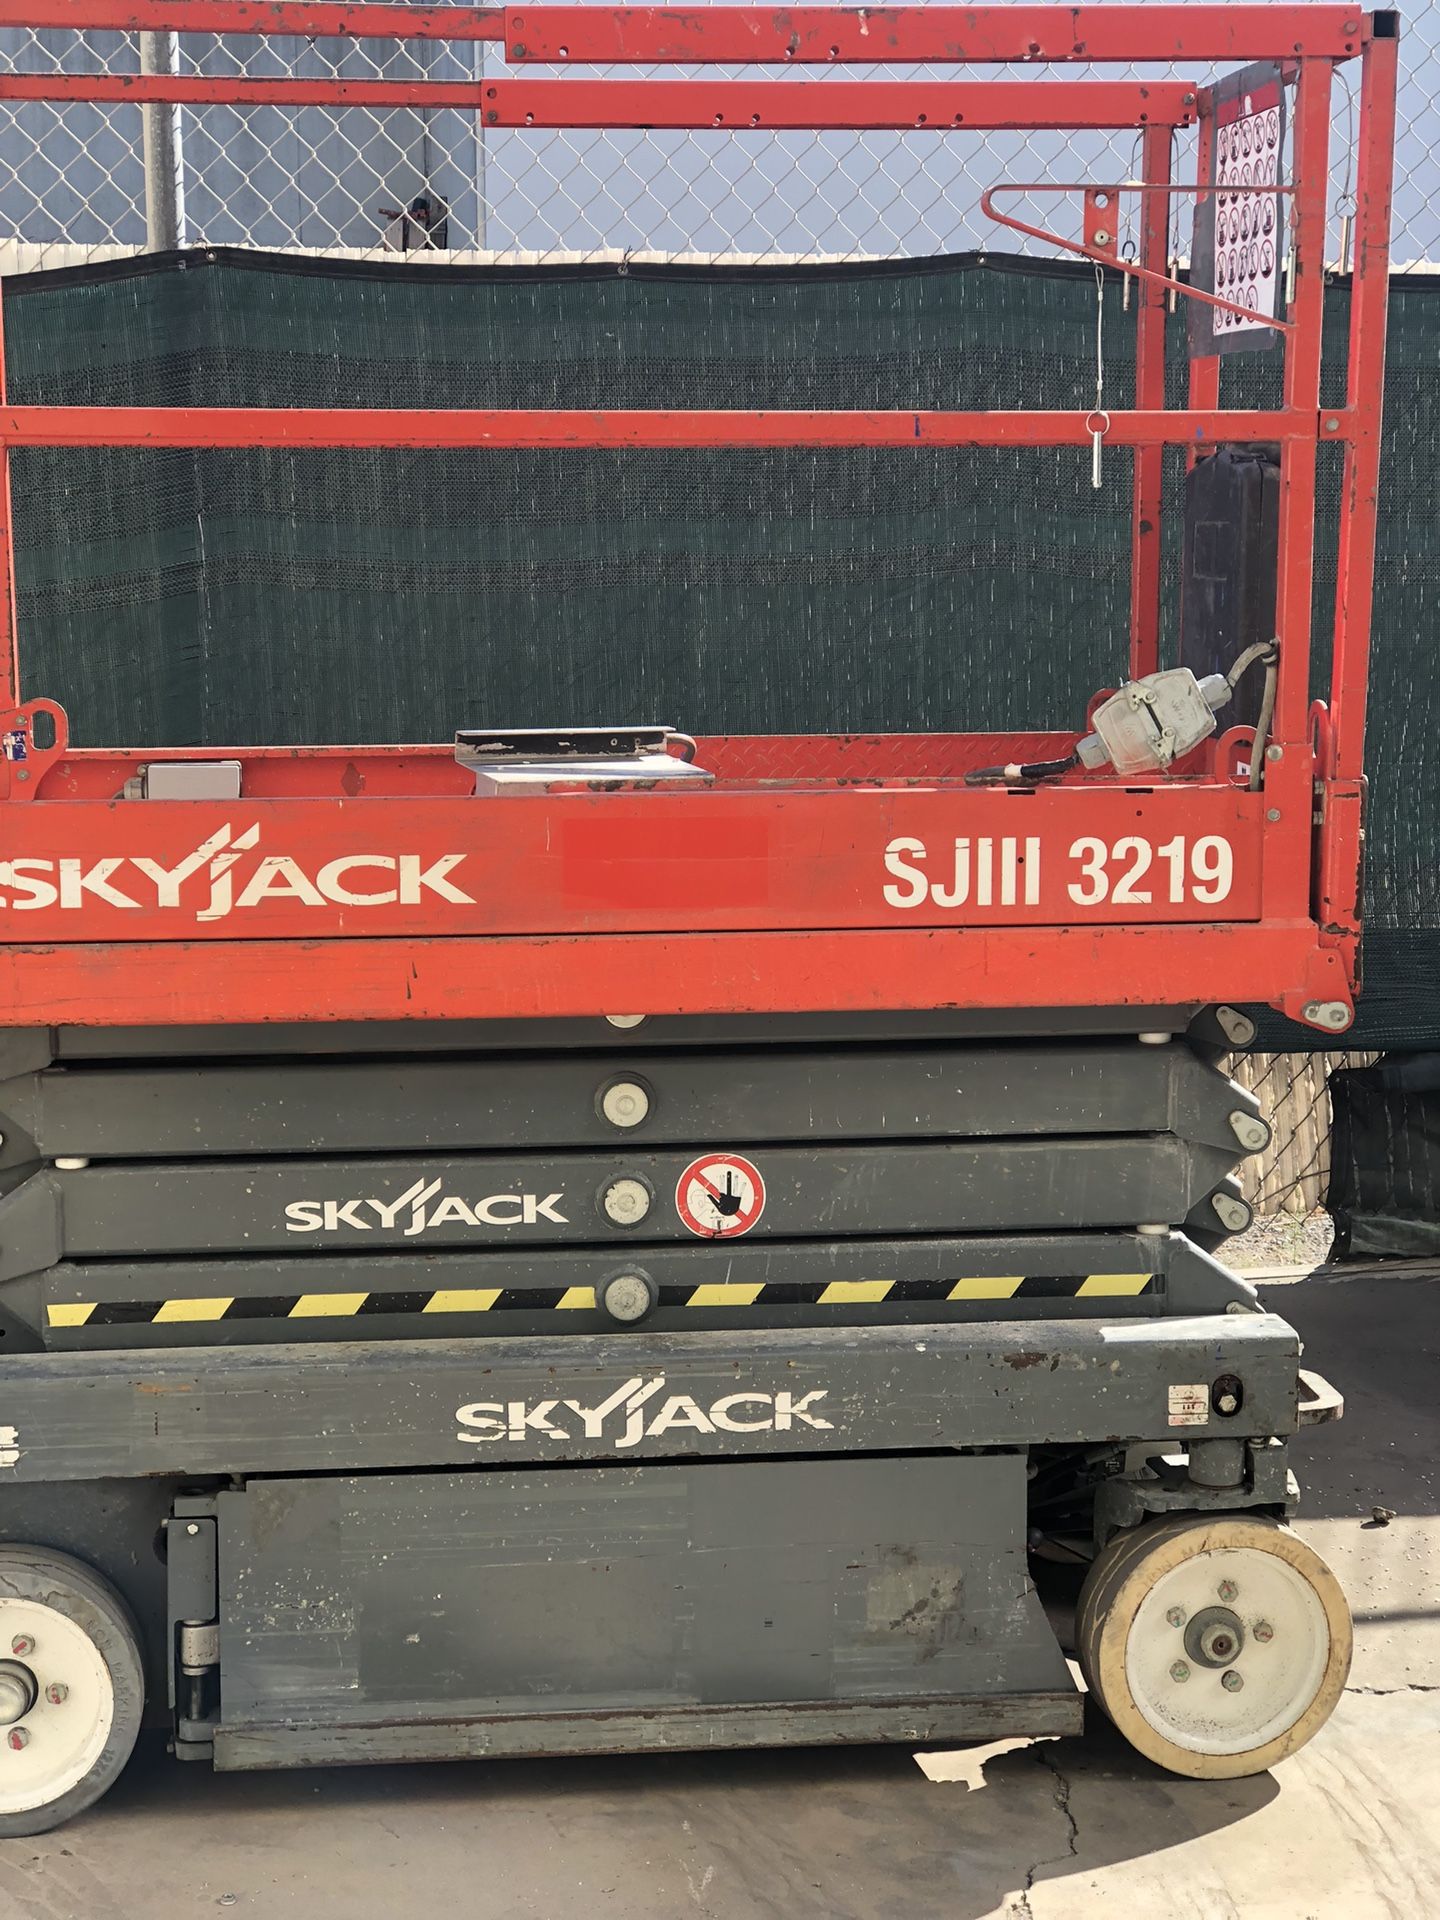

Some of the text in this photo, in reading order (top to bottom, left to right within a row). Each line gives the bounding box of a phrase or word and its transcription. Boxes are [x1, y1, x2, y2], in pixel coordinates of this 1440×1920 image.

[0, 821, 477, 921] SKYJACK
[883, 835, 1234, 908] SJIII 3219
[284, 1177, 569, 1236] SKYJACK
[455, 1377, 834, 1448] SKYJACK
[111, 1661, 129, 1738] MARKING
